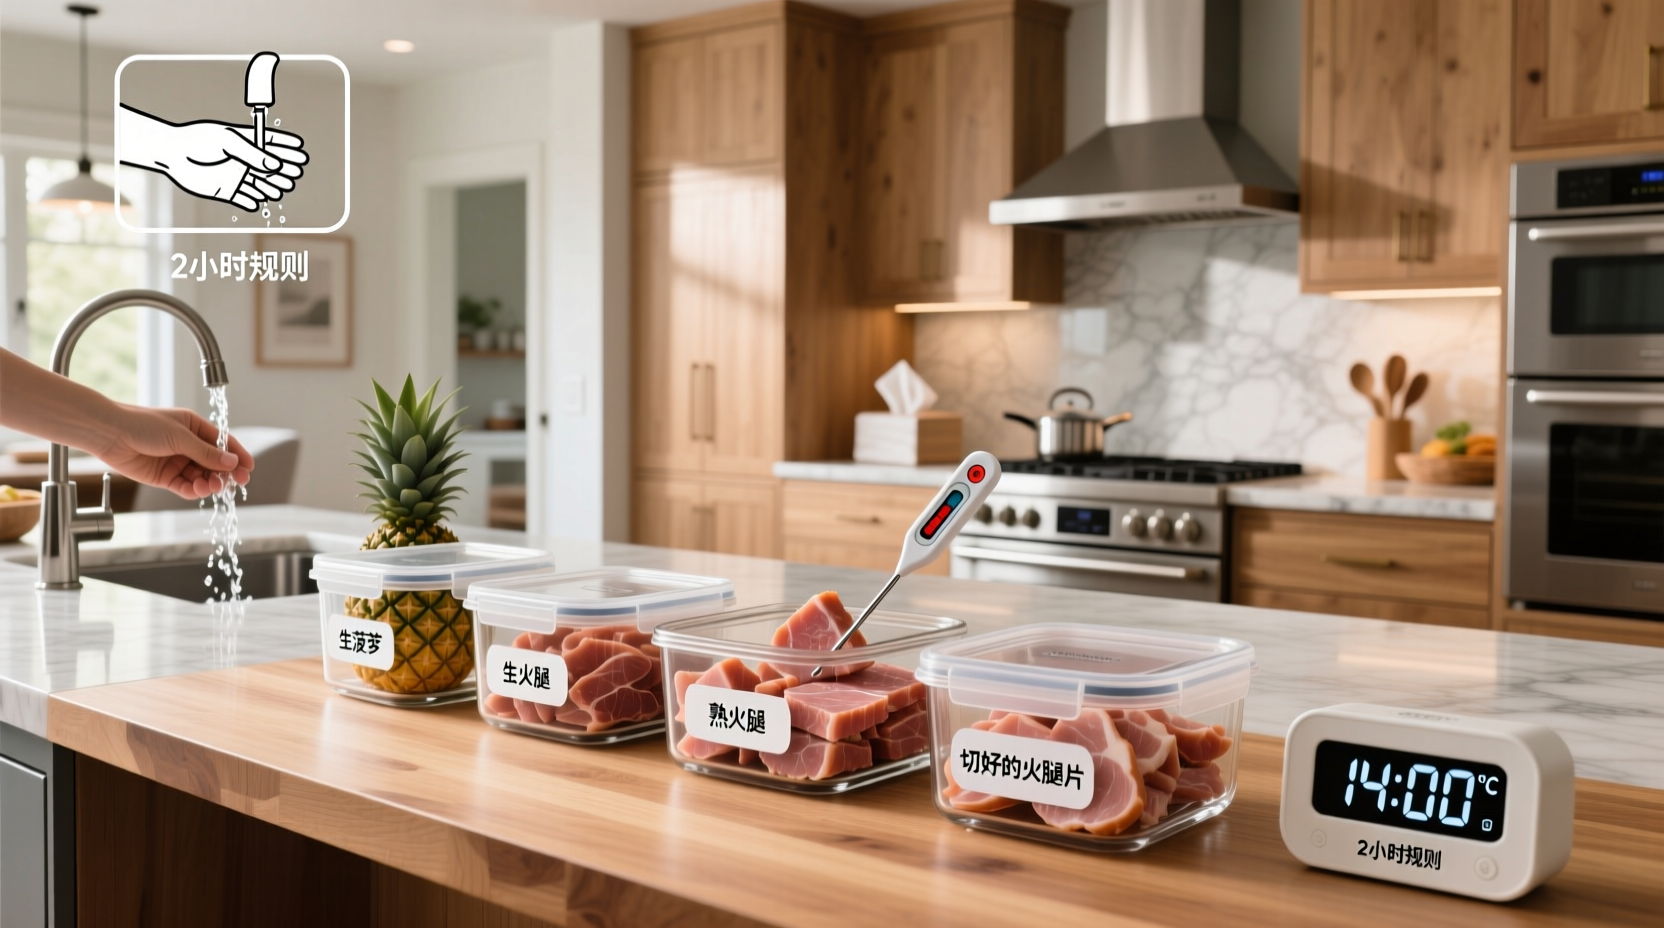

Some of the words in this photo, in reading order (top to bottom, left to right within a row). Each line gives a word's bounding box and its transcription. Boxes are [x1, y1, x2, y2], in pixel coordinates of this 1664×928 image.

[503, 660, 550, 690] 生火腿
[708, 702, 766, 734] 熟火腿
[959, 748, 1085, 790] 切好的火腿片
[1344, 758, 1475, 827] 14:00
[1357, 839, 1442, 871] 2小时规则
